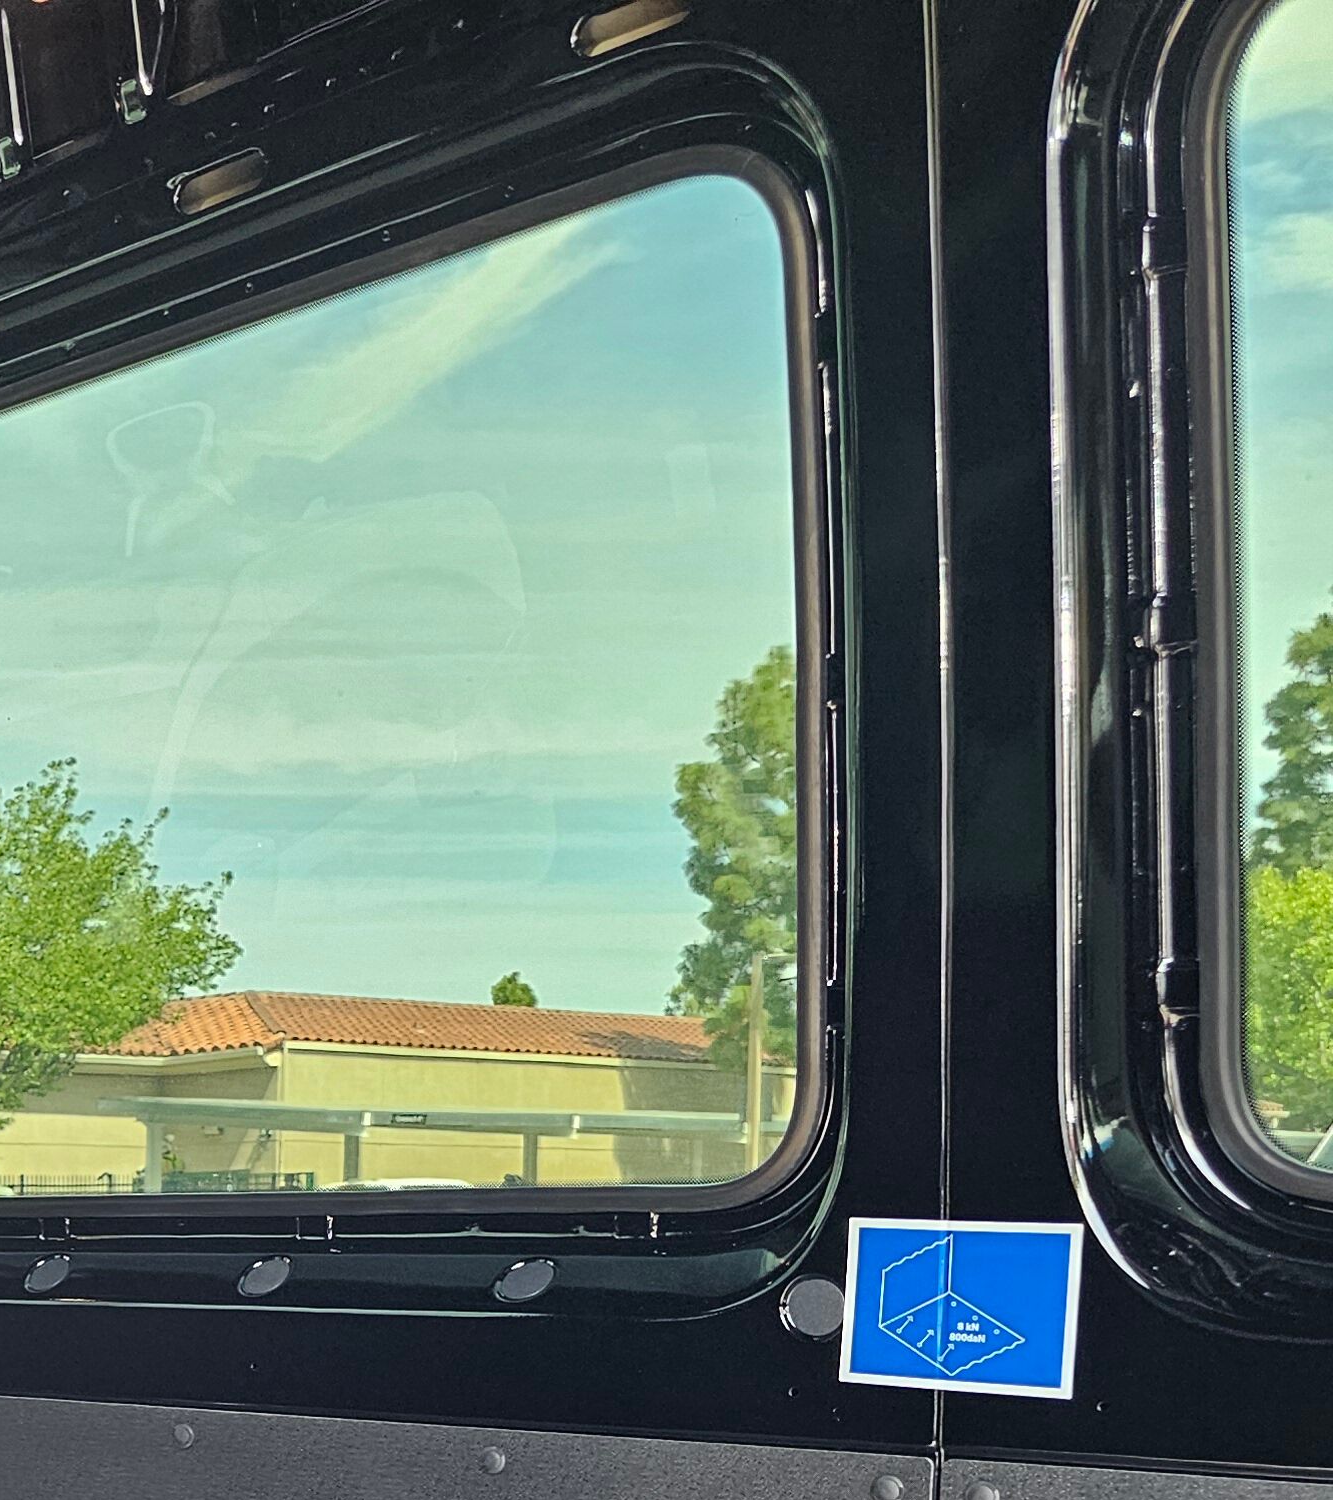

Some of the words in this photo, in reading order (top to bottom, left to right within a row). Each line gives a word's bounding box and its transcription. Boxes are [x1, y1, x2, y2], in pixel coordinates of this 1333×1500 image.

[957, 1322, 964, 1331] 8
[965, 1322, 980, 1332] kN
[949, 1332, 986, 1343] 800daN
